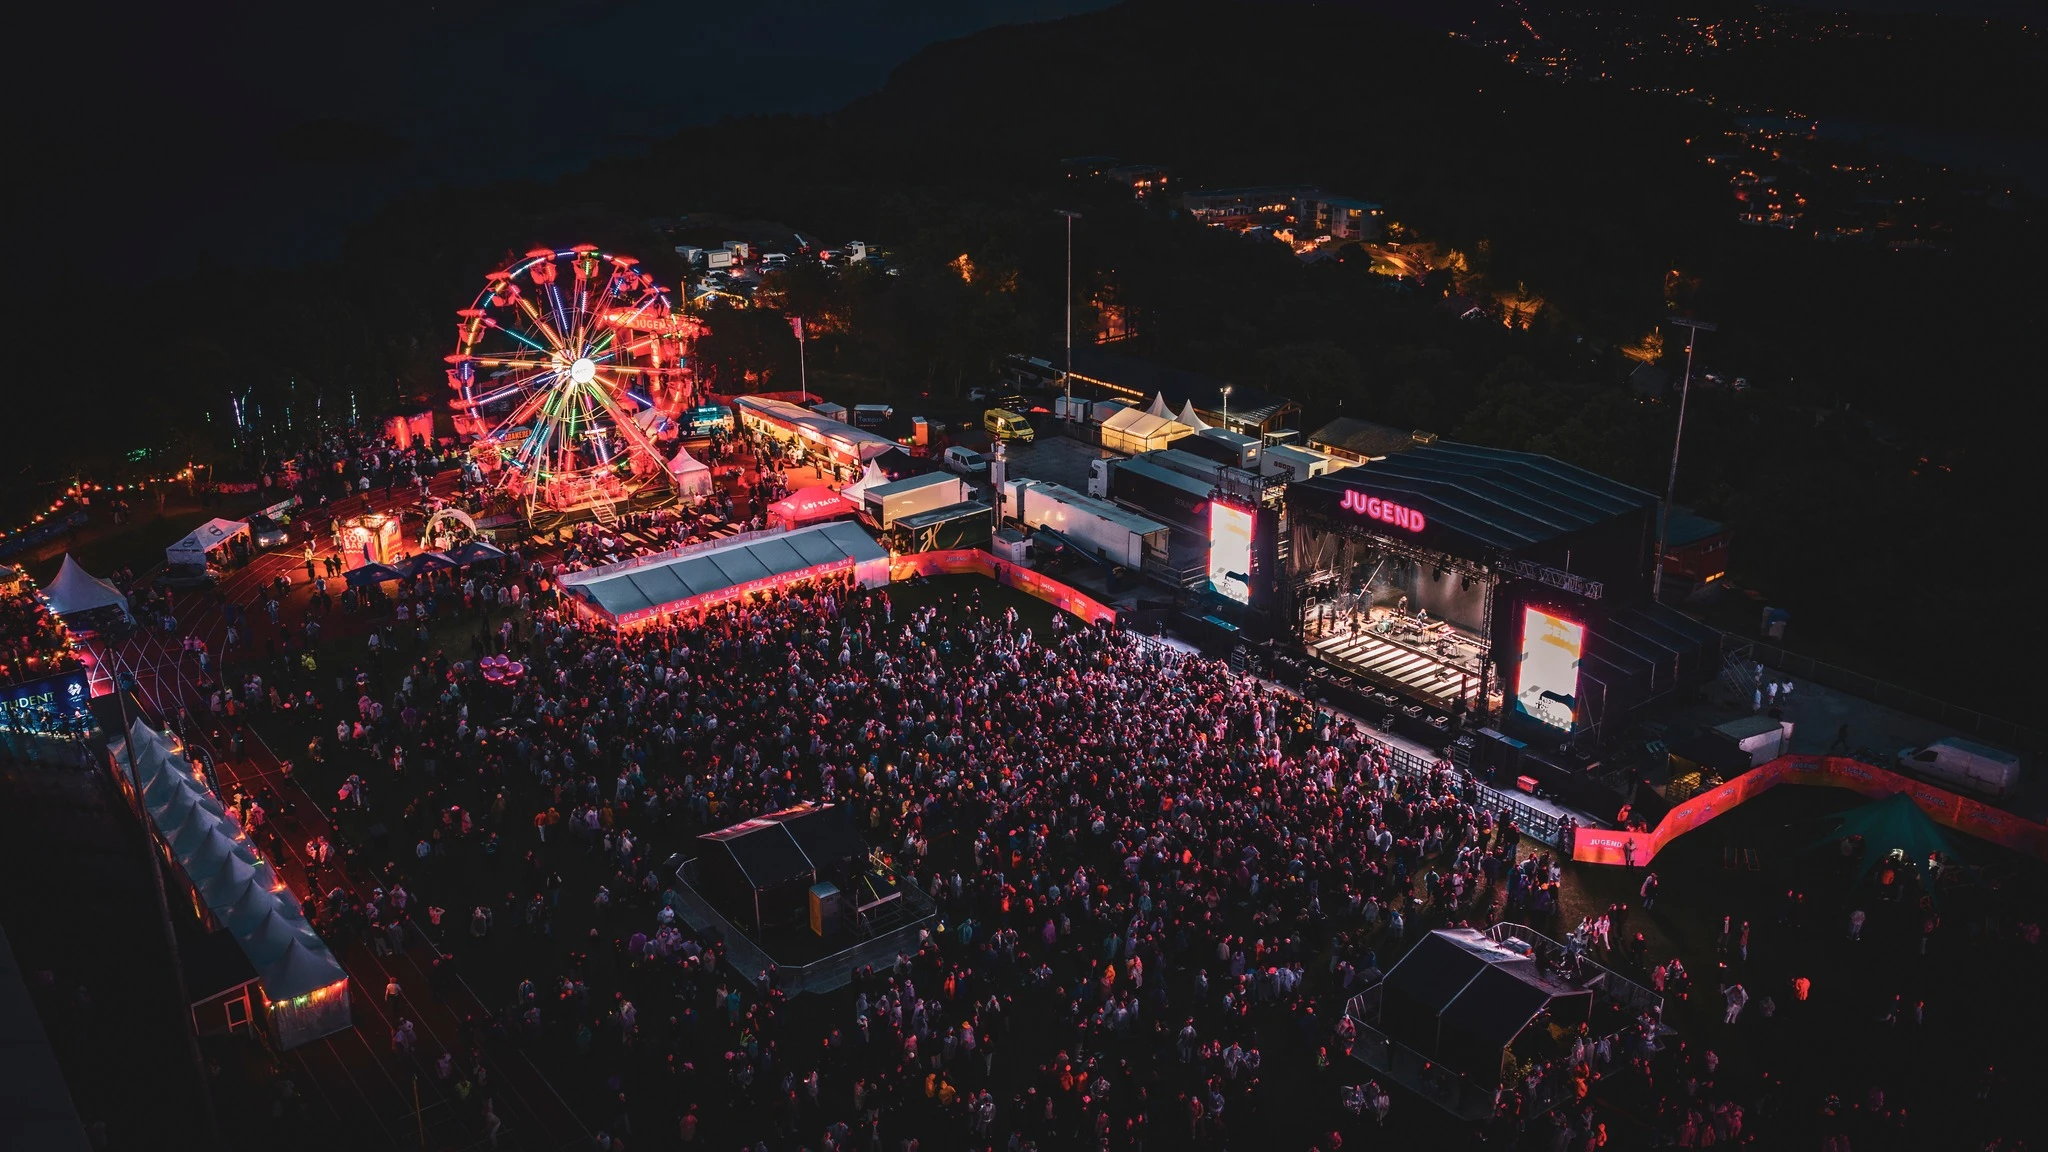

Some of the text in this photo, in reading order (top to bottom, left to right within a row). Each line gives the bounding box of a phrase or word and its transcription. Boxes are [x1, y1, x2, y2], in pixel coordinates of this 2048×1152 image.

[635, 318, 667, 330] JUGEN
[802, 502, 817, 511] LOS
[818, 497, 841, 507] TACOS
[1340, 489, 1425, 533] JUGEND
[343, 535, 374, 544] COURT
[838, 558, 853, 567] BAR
[817, 564, 830, 573] BAR
[794, 569, 810, 578] BAR
[771, 575, 787, 584] BAR
[748, 580, 763, 589] BAR
[724, 587, 740, 596] BAR
[700, 594, 715, 602] BAR
[674, 600, 690, 609] BAR
[649, 606, 665, 615] BAR
[623, 612, 639, 622] BAR
[0, 692, 54, 711] TUDENT
[1590, 839, 1622, 848] JUGEND
